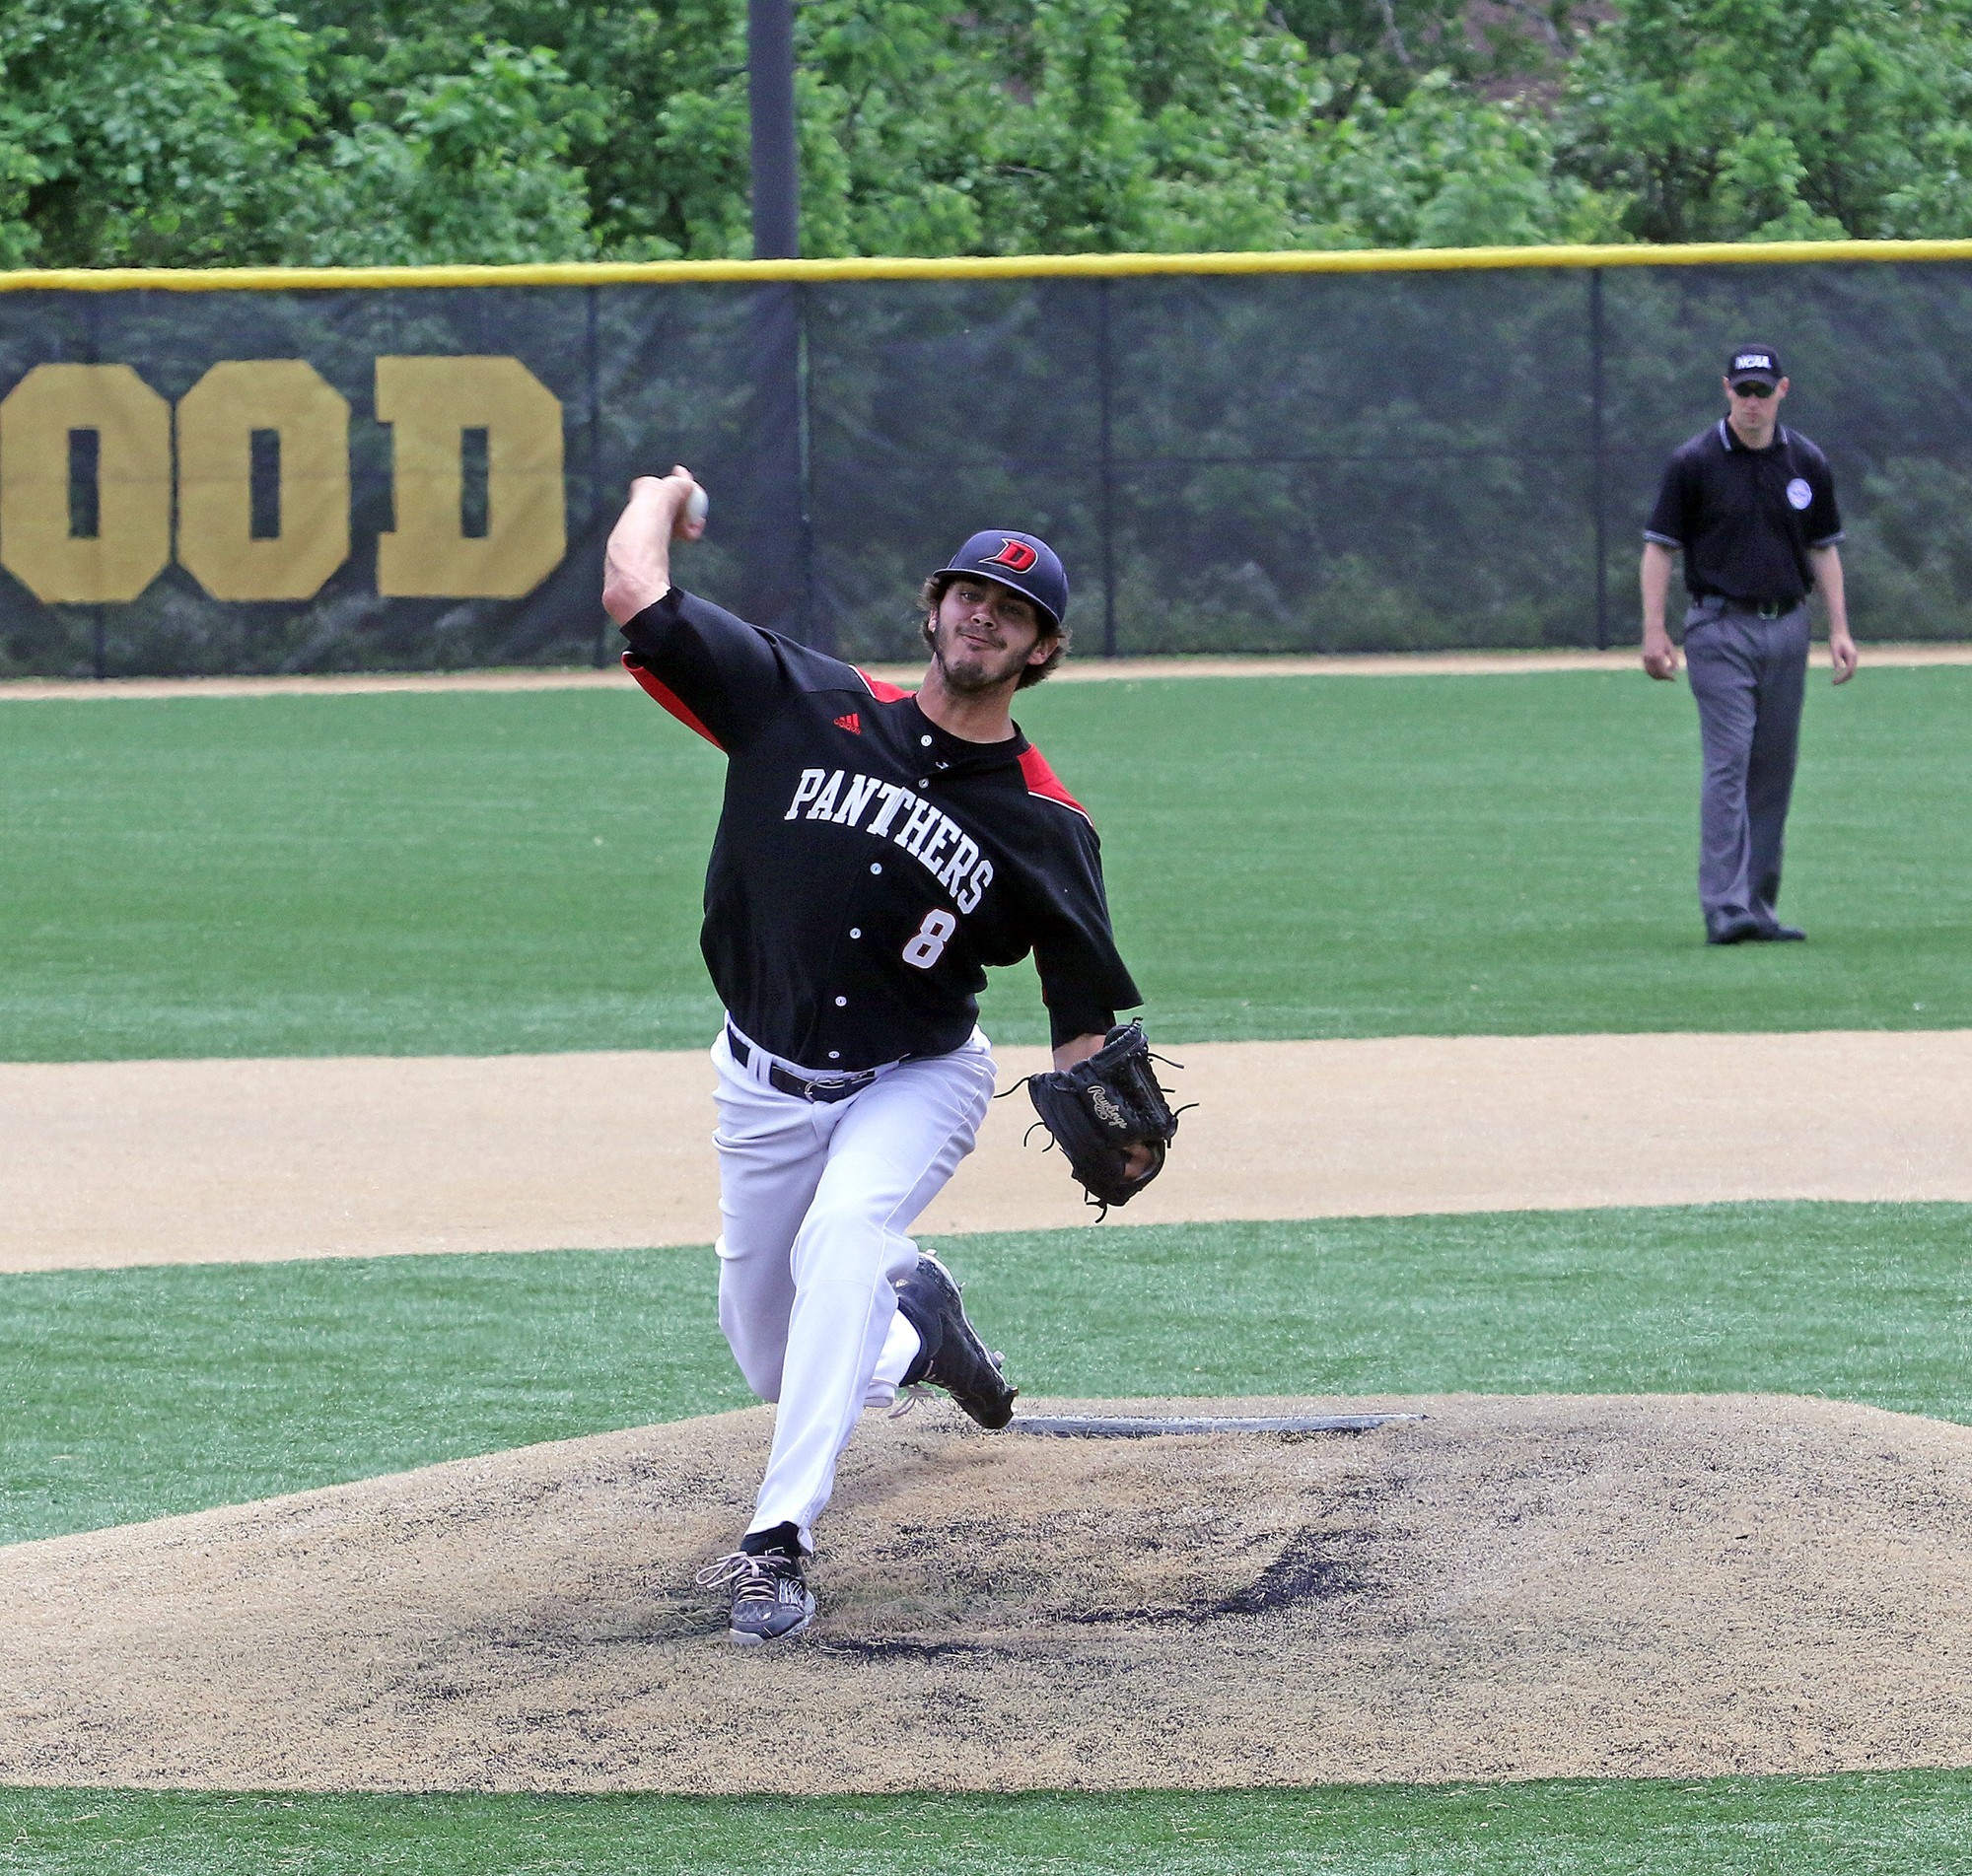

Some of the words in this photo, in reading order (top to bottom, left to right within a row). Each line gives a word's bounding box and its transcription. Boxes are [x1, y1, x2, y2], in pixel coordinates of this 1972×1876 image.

[1735, 354, 1772, 370] NCAA
[0, 355, 567, 605] OOD
[978, 537, 1038, 575] D
[784, 767, 994, 915] PANTHERS
[902, 908, 956, 969] 8
[1087, 1085, 1128, 1129] Rawlings
